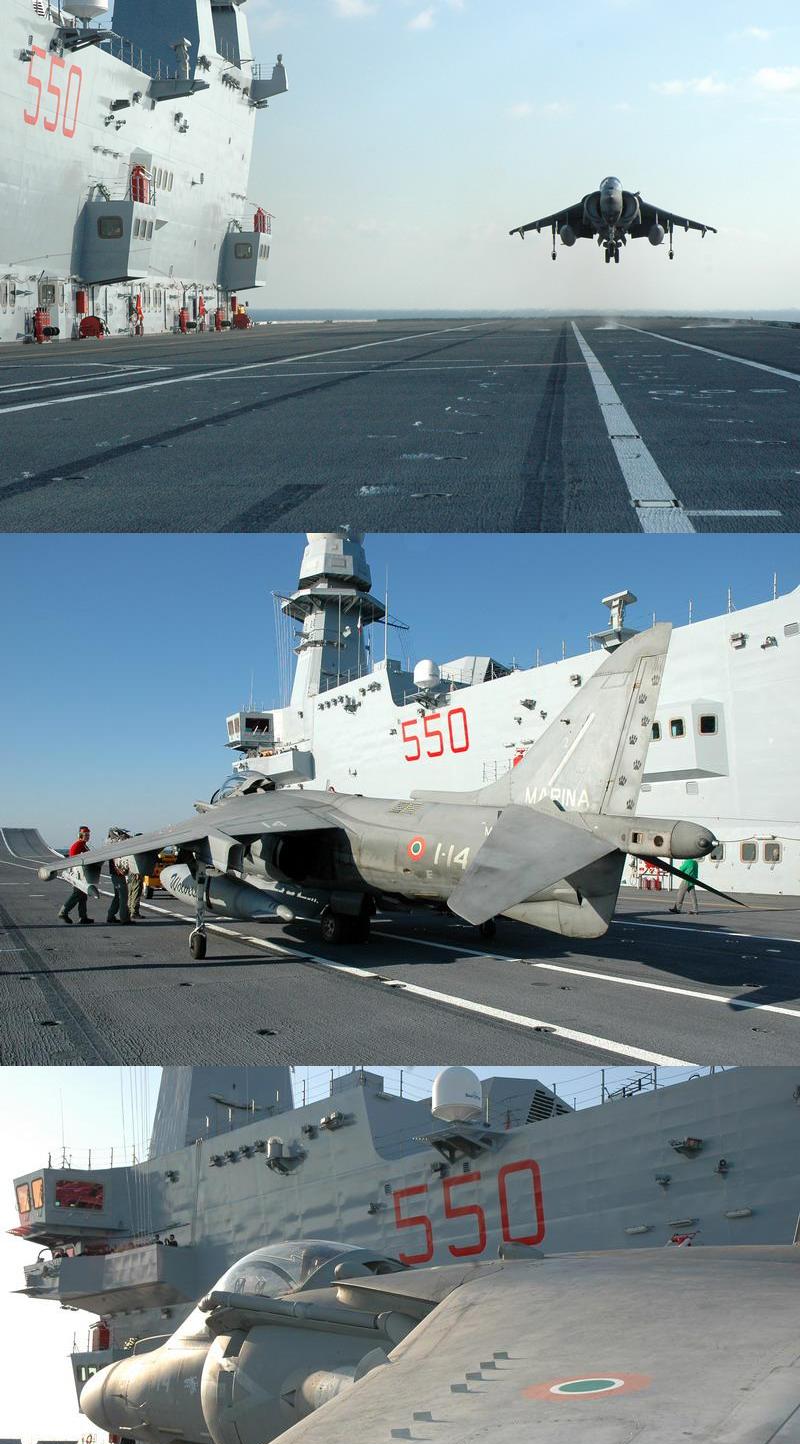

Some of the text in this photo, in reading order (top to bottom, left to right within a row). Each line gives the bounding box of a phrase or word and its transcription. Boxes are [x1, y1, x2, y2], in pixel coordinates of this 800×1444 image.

[23, 44, 82, 139] 550
[401, 707, 469, 761] 550
[525, 786, 589, 808] MARINA
[393, 1158, 545, 1265] 550
